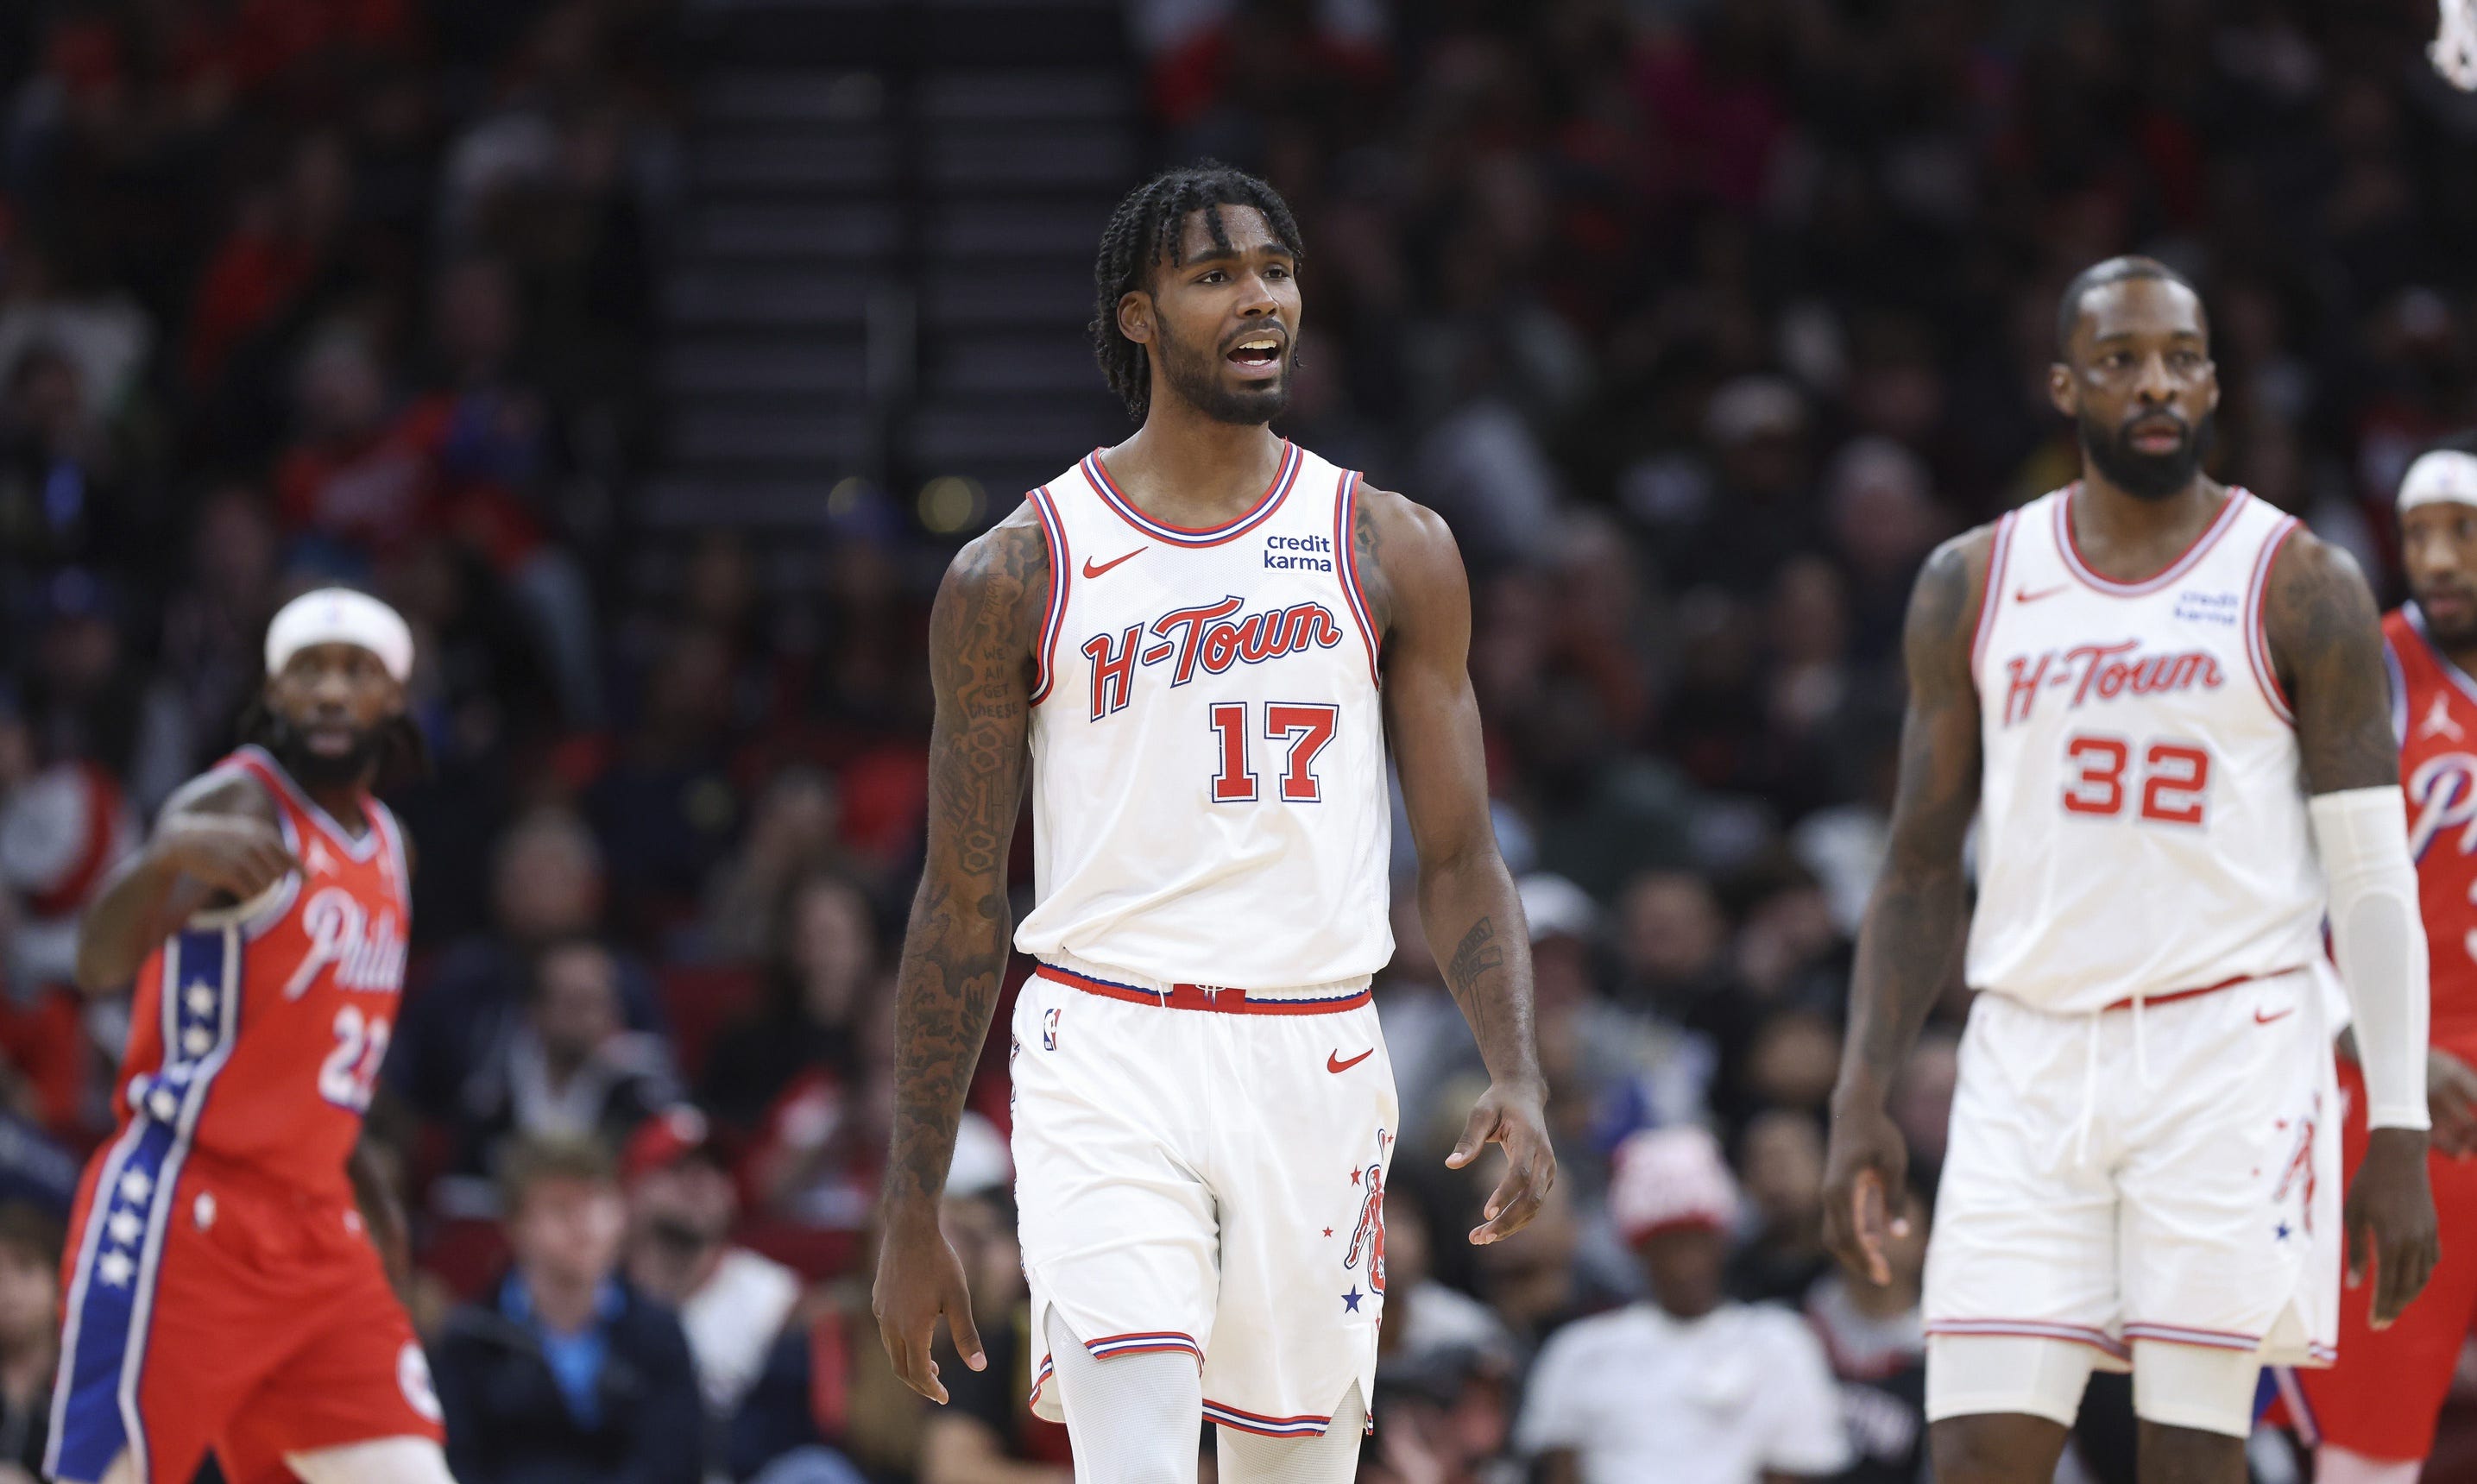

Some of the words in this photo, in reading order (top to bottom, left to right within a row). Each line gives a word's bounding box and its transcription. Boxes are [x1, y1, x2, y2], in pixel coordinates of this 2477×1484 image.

[1264, 550, 1332, 572] karma
[1267, 535, 1330, 552] credit
[984, 682, 1010, 699] GET
[1081, 594, 1343, 724] H-Town
[2003, 638, 2224, 729] H-Town
[1209, 701, 1340, 803] 17
[2063, 736, 2210, 827] 32
